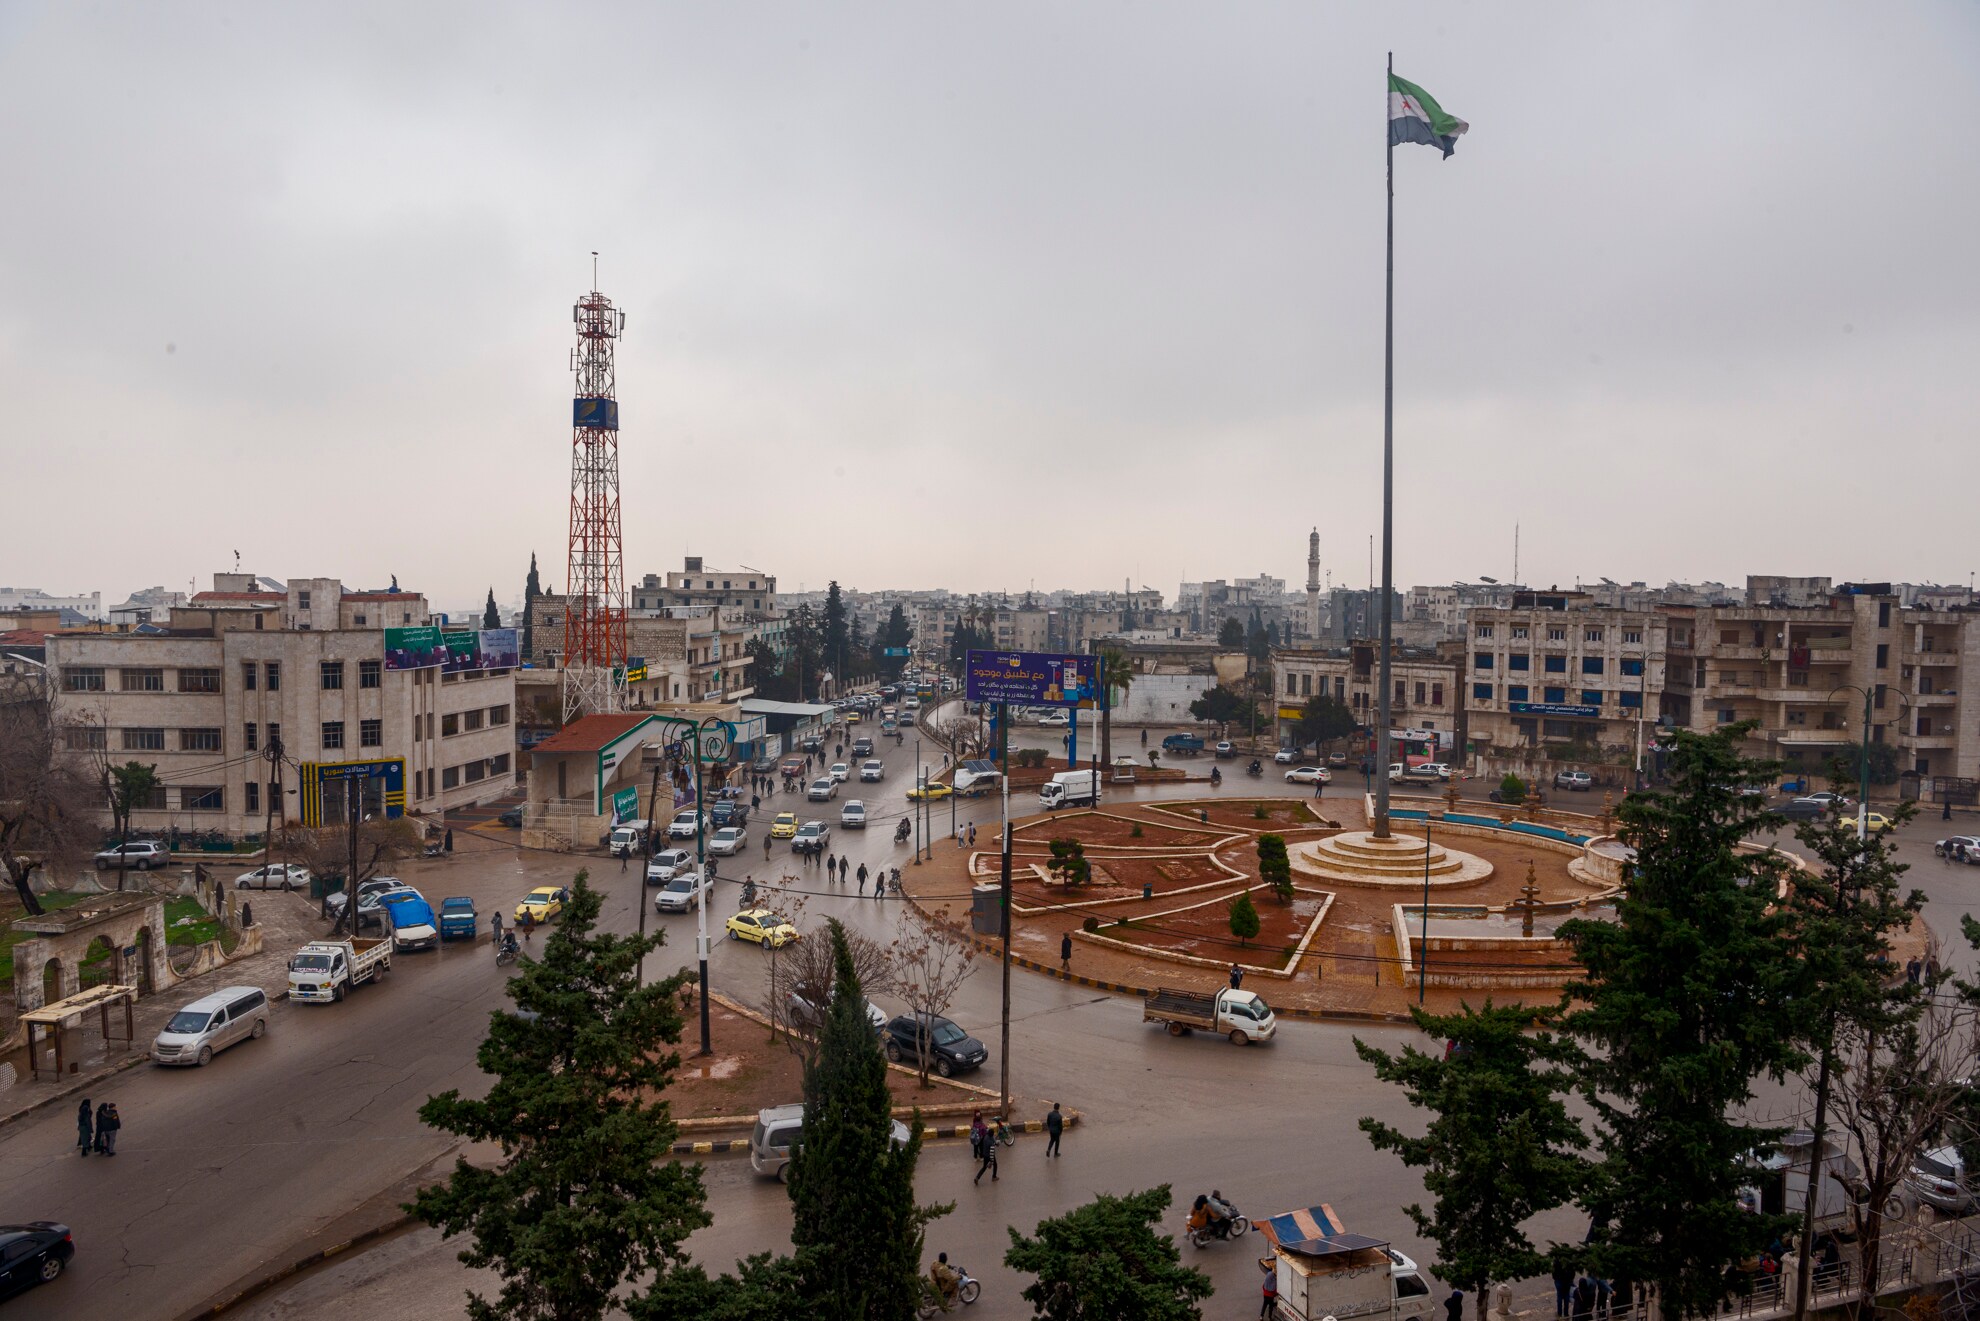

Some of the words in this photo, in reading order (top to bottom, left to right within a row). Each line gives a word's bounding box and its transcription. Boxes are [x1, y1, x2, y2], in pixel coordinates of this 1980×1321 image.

[974, 669, 1001, 678] موجود
[1004, 669, 1030, 679] تطبيق
[1032, 673, 1045, 681] مع
